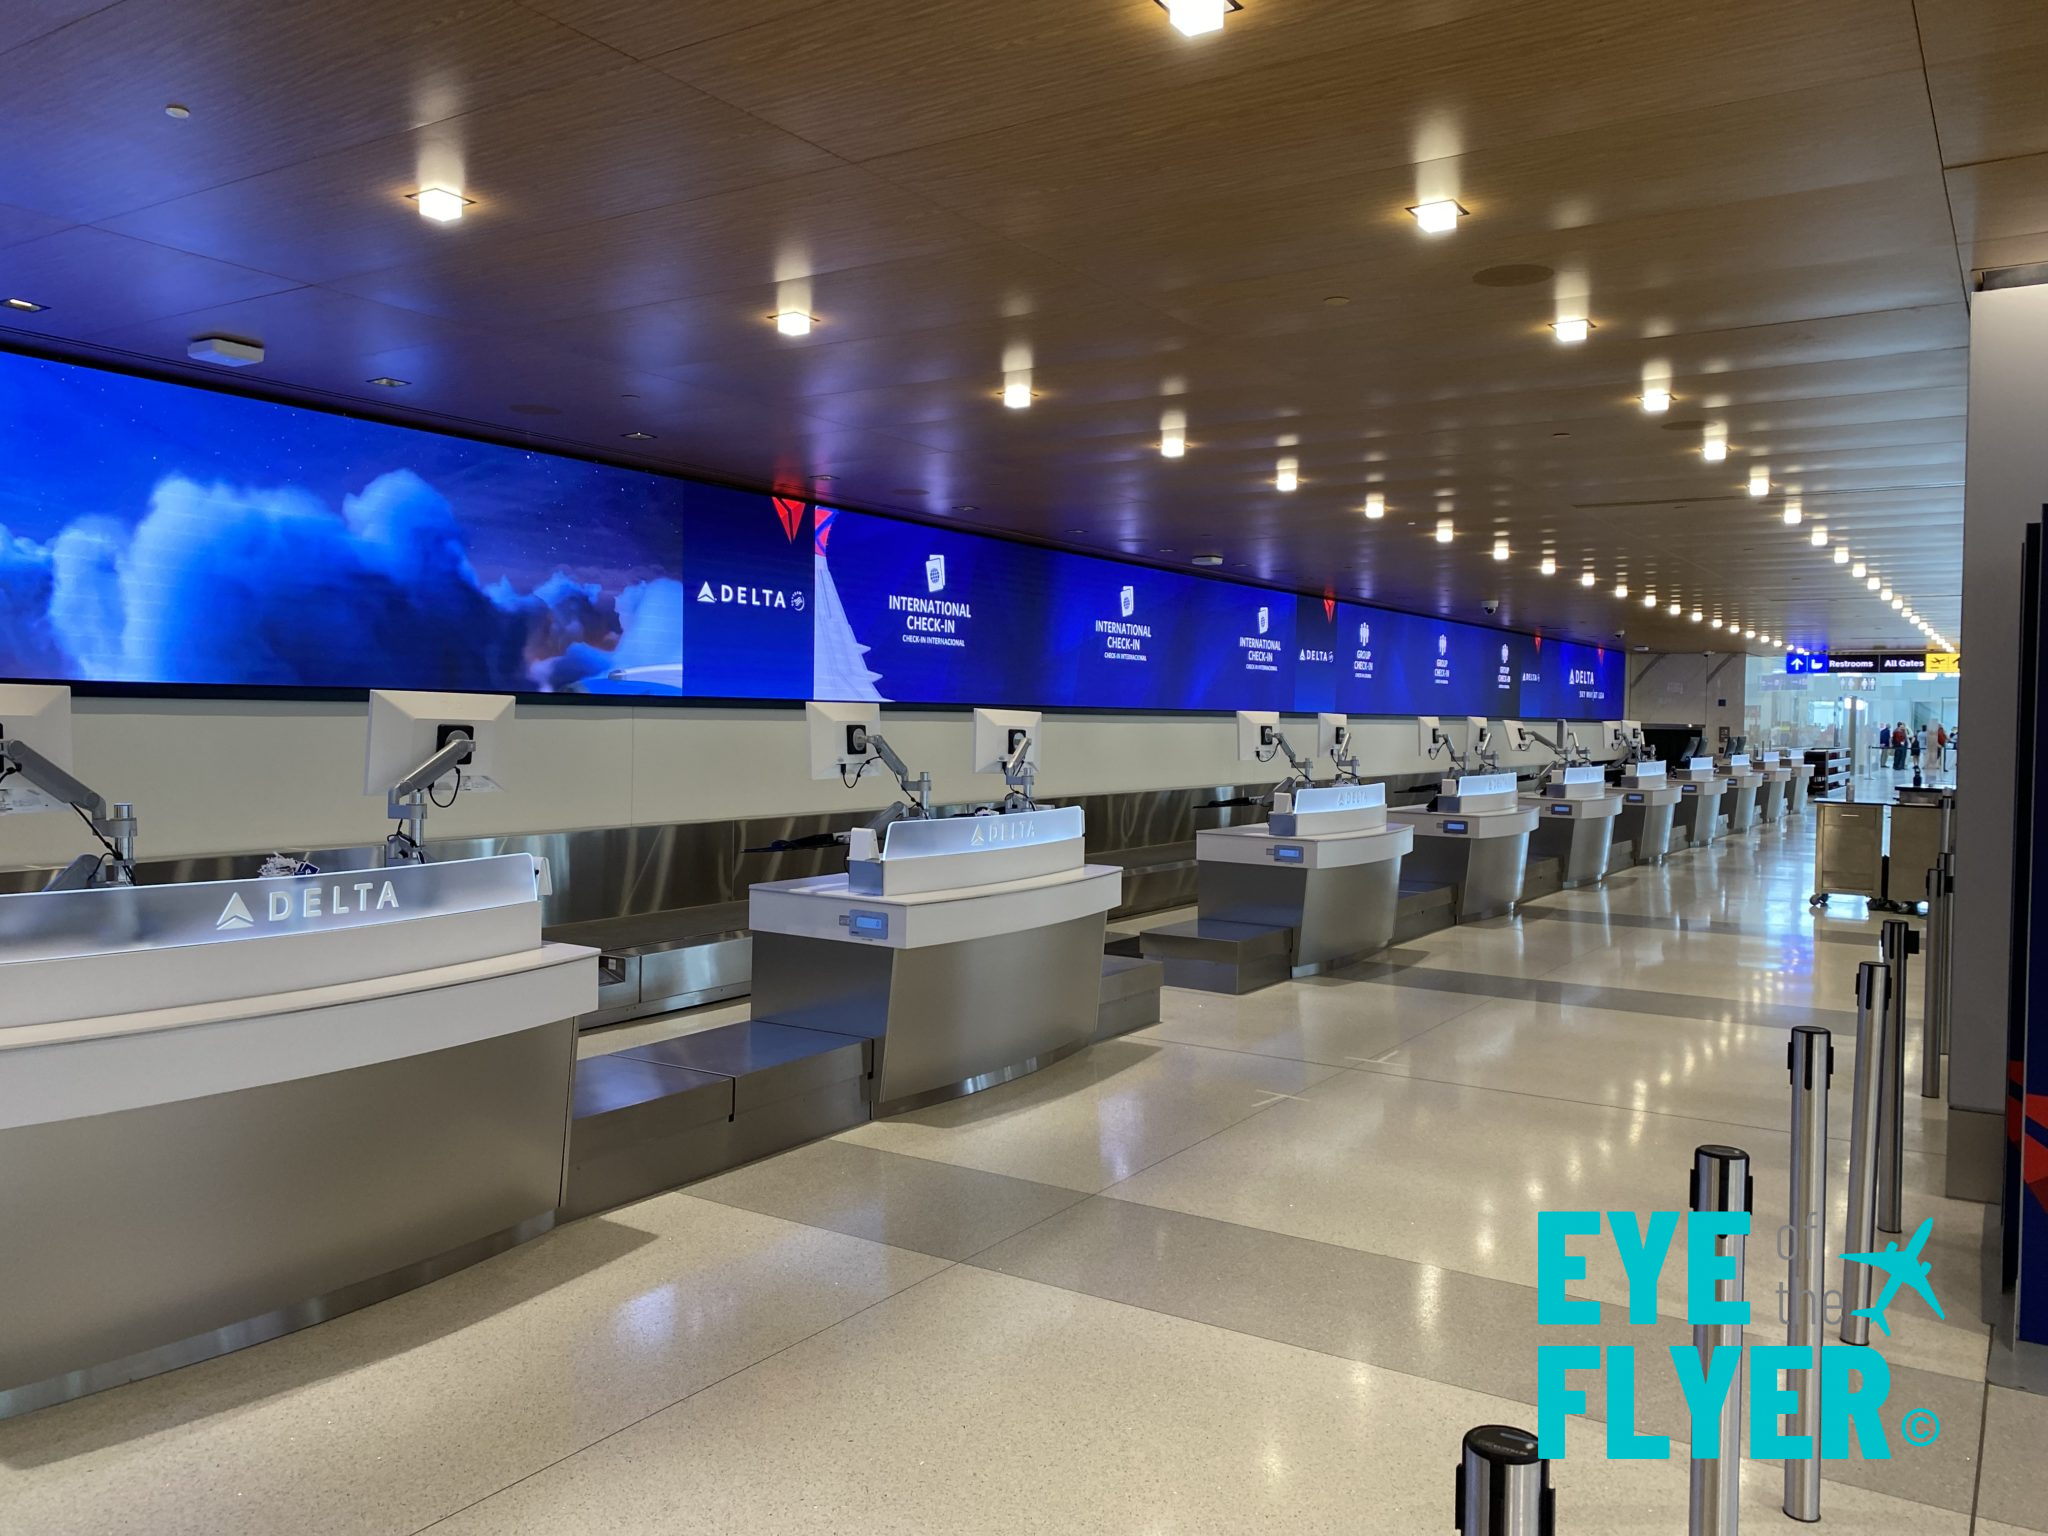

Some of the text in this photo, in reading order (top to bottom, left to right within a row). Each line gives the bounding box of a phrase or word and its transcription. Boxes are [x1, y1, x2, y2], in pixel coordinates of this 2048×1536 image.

[721, 584, 786, 609] DELTA
[889, 594, 972, 618] INTERNATIONAL
[906, 615, 955, 634] CHECK-IN
[1095, 620, 1152, 638] INTERNATIONAL
[902, 634, 926, 644] CHECK-IN
[1107, 636, 1141, 651] CHECK-IN
[1239, 637, 1282, 651] INTERNATIONAL
[1248, 651, 1273, 662] CHECK-IN
[1306, 649, 1328, 662] DELTA
[1829, 660, 1874, 668] Restrooms
[1899, 660, 1924, 668] Gates
[1575, 669, 1594, 685] DELTA
[989, 820, 1035, 842] DELTA
[268, 879, 400, 922] DELTA
